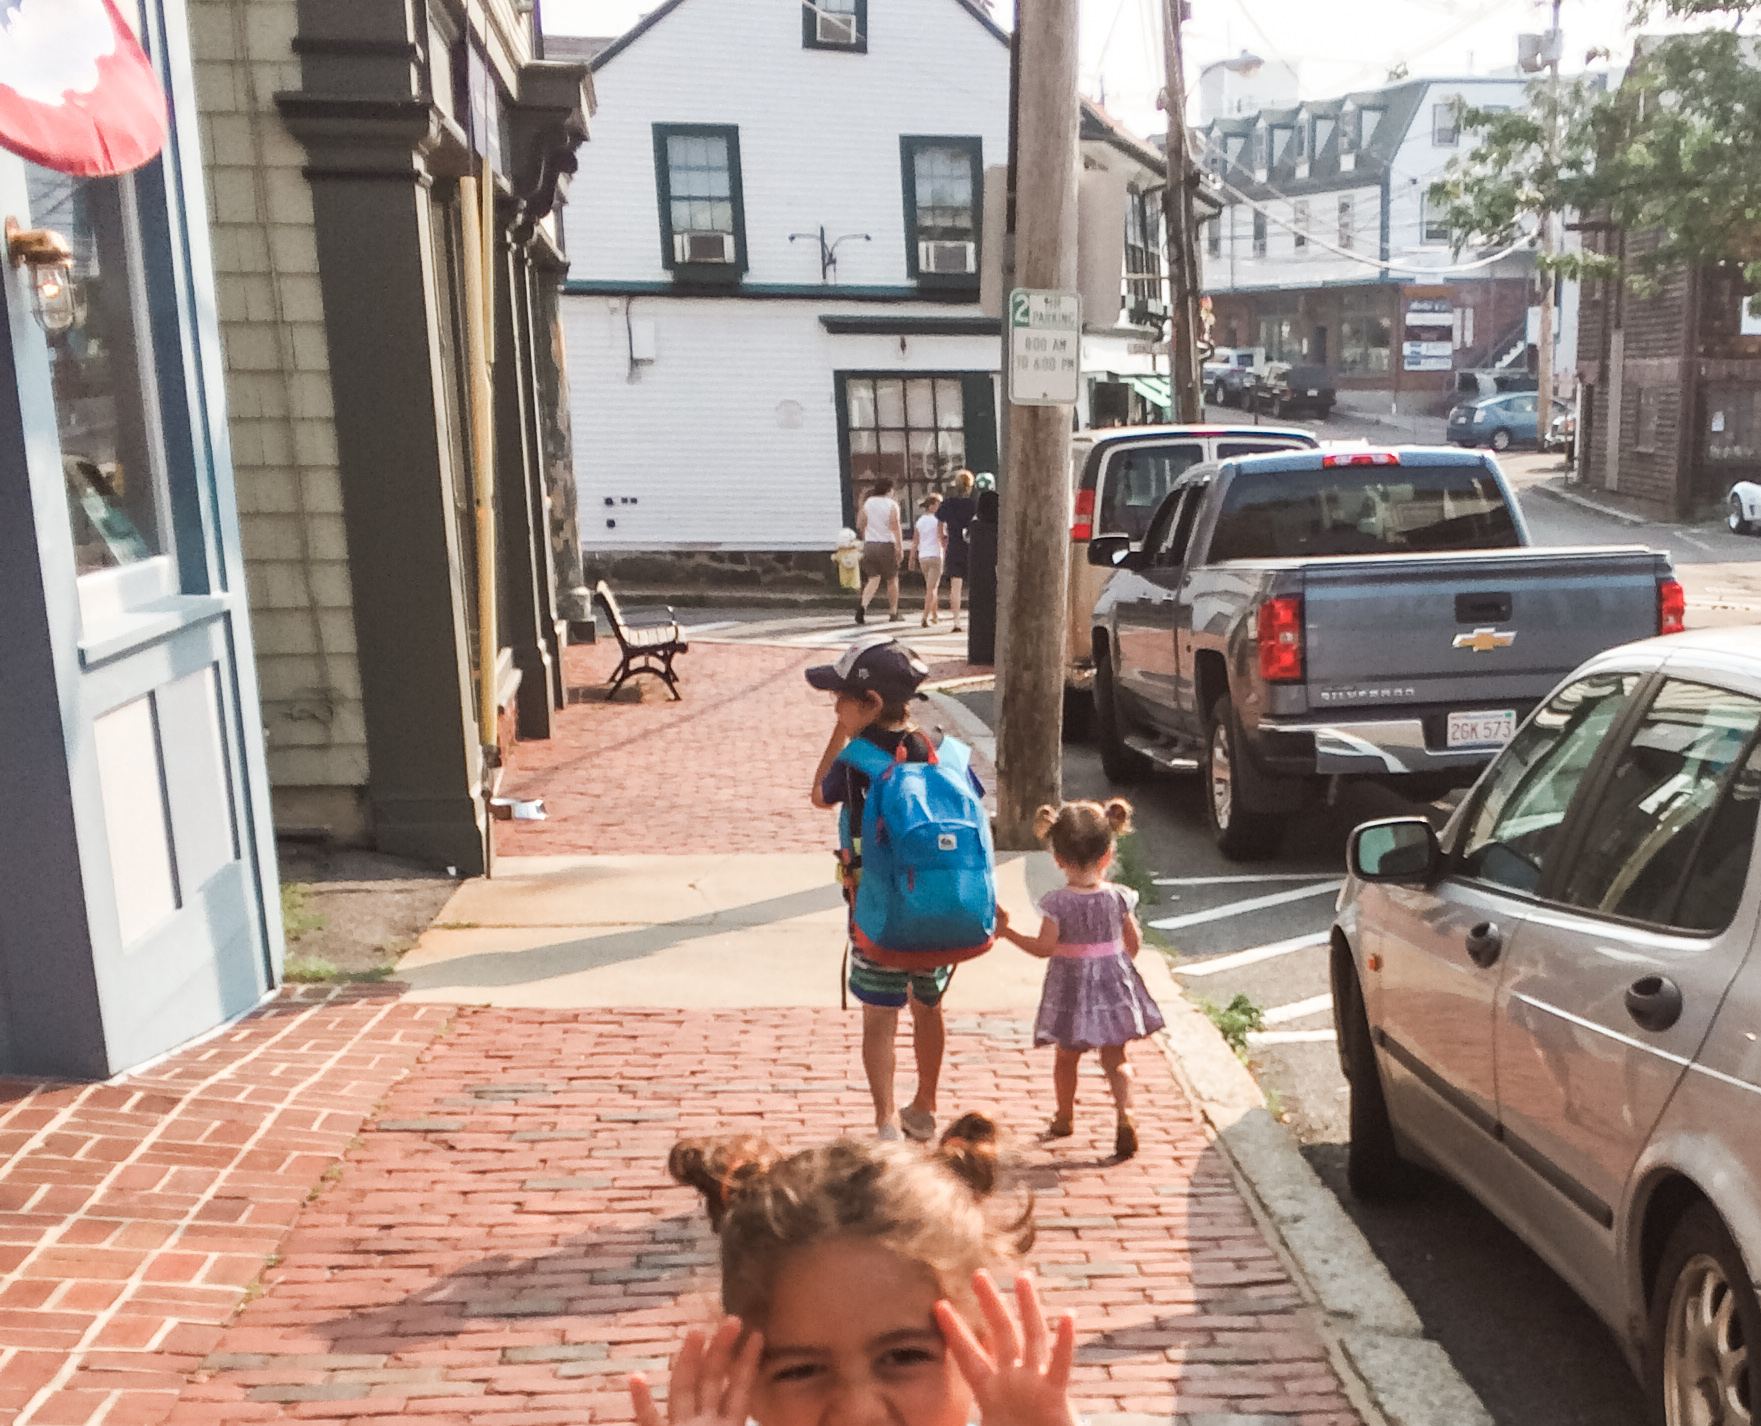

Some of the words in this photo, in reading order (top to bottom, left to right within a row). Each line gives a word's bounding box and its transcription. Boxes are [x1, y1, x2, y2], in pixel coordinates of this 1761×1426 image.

[1015, 294, 1029, 323] 2
[1033, 312, 1075, 324] PARKING
[1052, 338, 1066, 352] AM
[1016, 355, 1028, 368] TO
[1061, 358, 1074, 371] PM
[1320, 687, 1414, 700] SILVERADO
